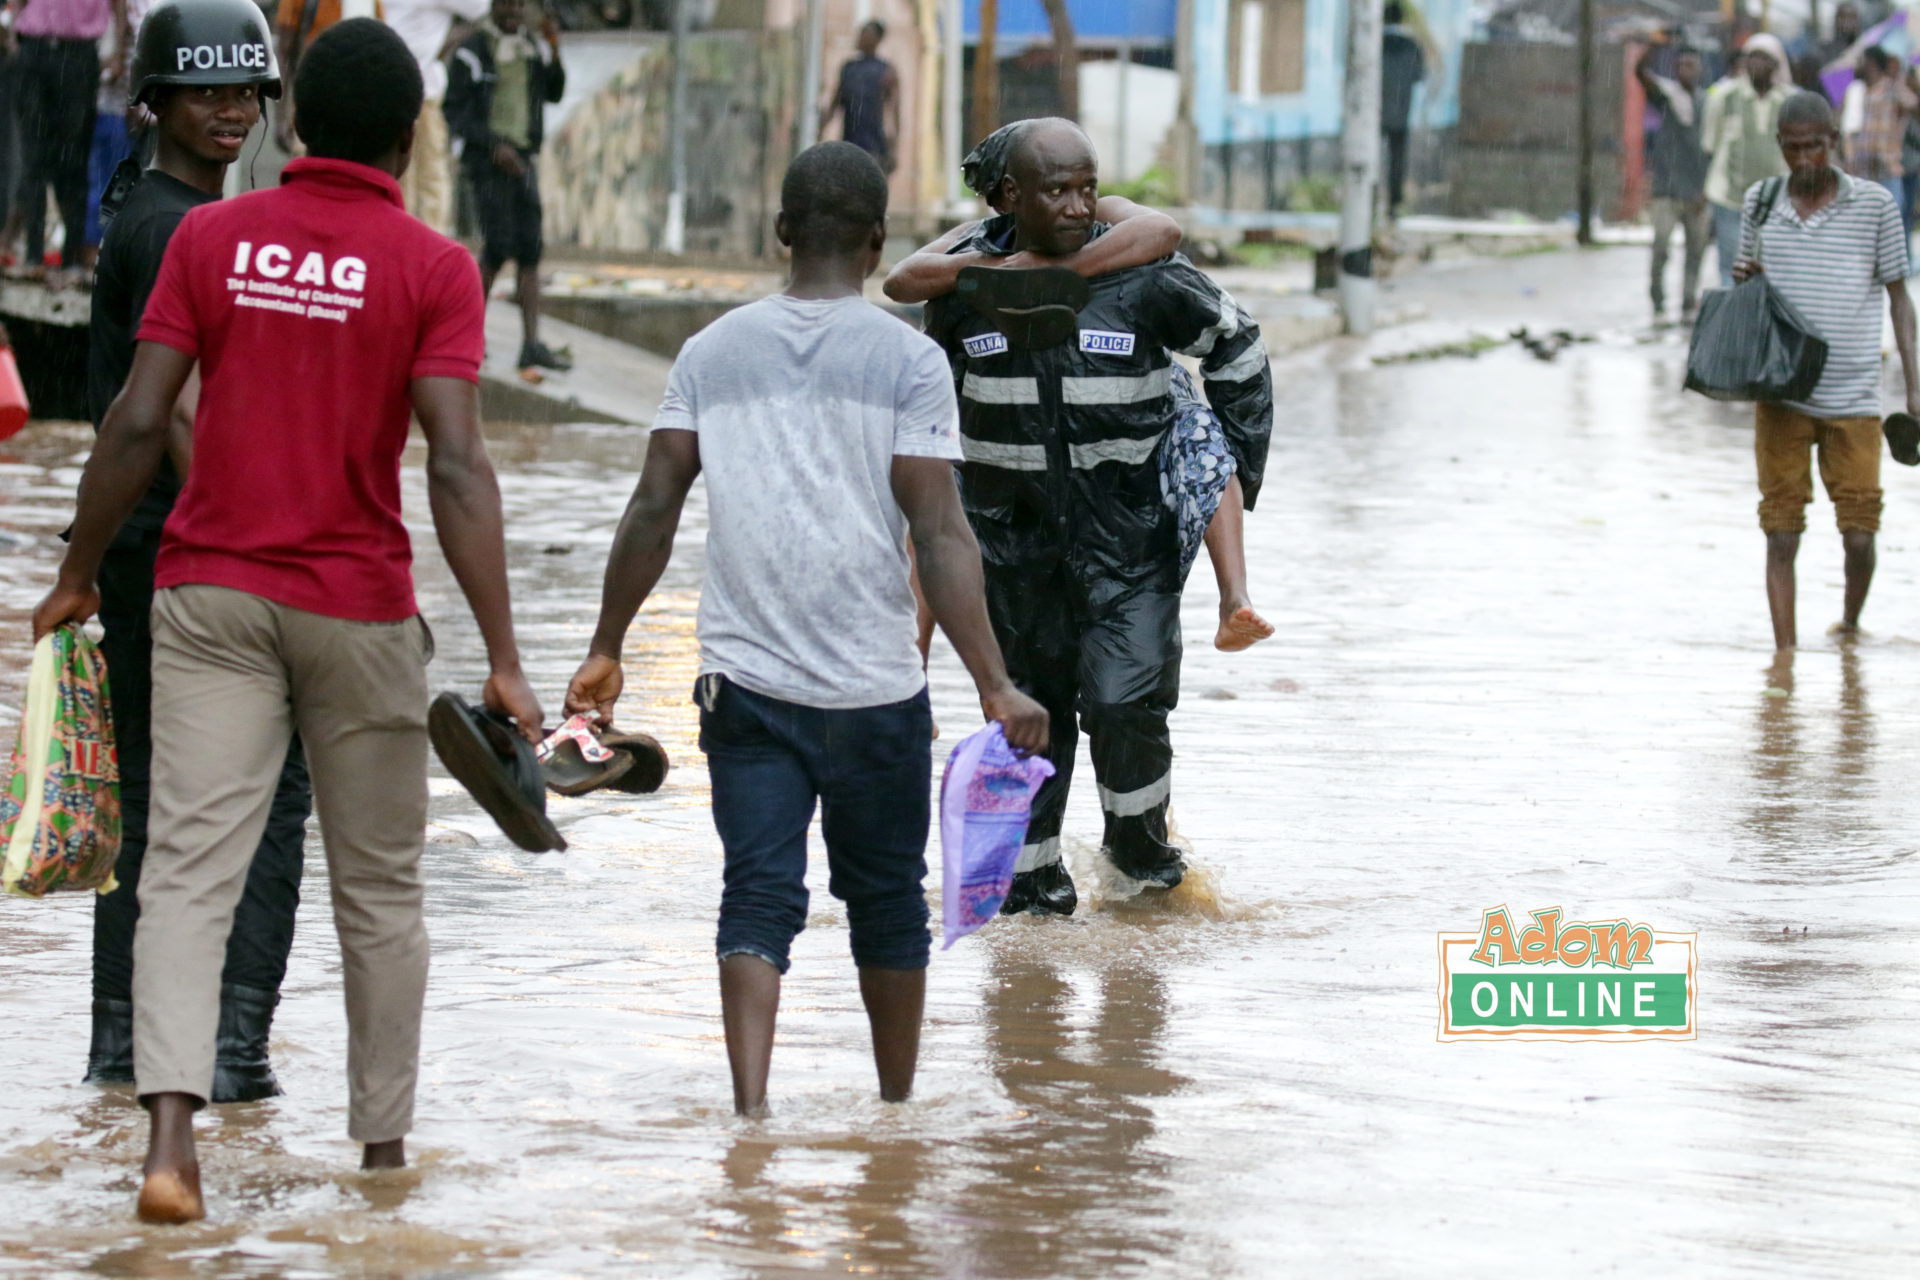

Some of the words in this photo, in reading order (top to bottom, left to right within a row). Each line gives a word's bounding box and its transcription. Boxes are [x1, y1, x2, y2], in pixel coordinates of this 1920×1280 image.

[176, 43, 266, 71] POLICE
[233, 241, 368, 292] ICAG
[226, 278, 247, 291] The
[247, 279, 297, 298] Institute
[297, 289, 311, 301] of
[311, 290, 365, 309] Chartered
[234, 293, 306, 315] Accountants
[965, 335, 1003, 355] GHANA
[1083, 335, 1131, 351] POLICE
